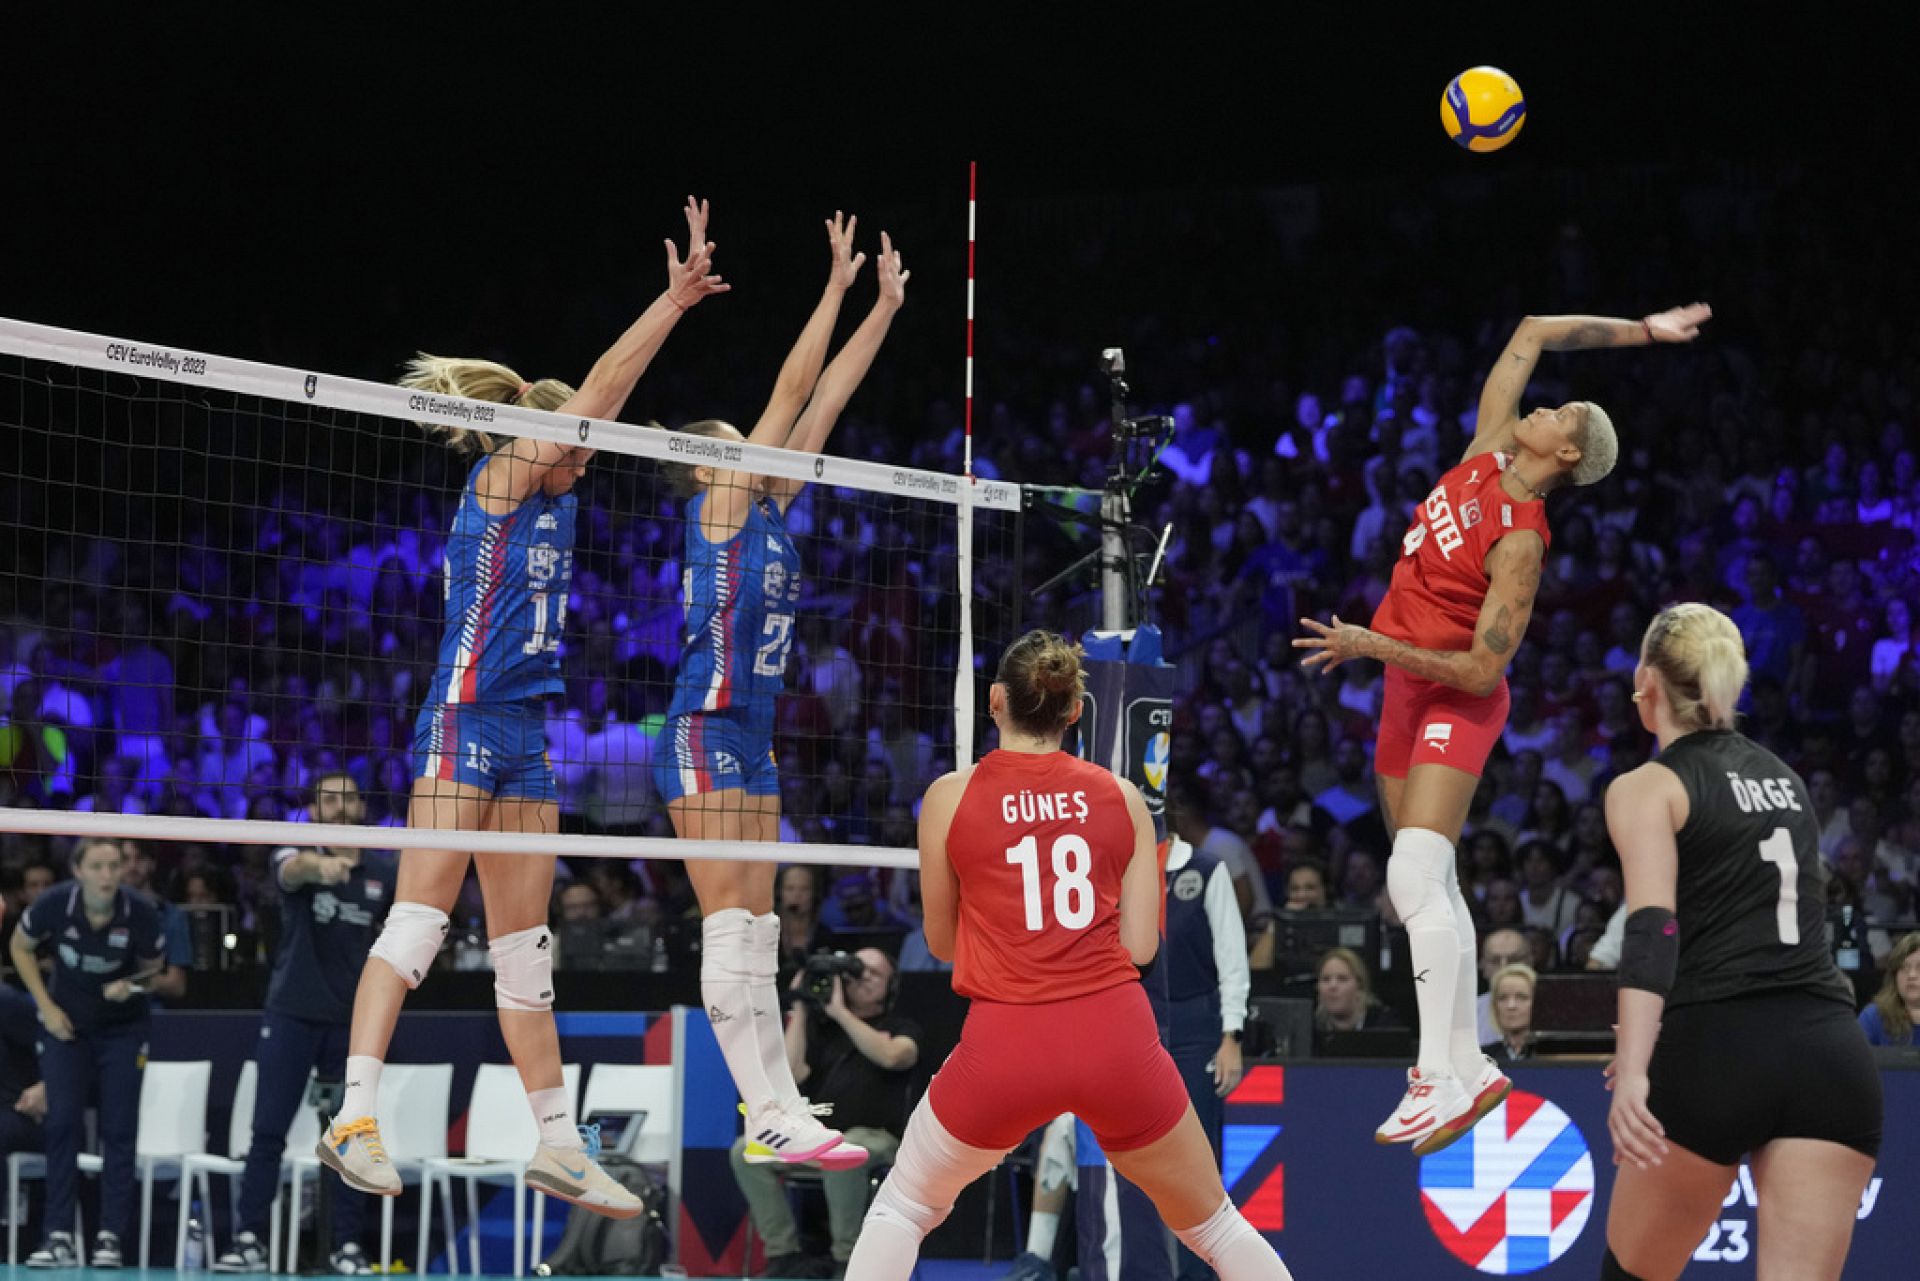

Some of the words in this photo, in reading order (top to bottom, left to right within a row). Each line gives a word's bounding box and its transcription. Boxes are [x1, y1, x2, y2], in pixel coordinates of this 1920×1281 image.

[106, 343, 130, 362] CEV
[129, 346, 181, 376] EuroVolley
[181, 356, 207, 376] 2023
[409, 395, 429, 412] CEV
[1002, 789, 1089, 824] GÜNEŞ
[1725, 770, 1803, 813] ÖRGE
[1006, 833, 1096, 931] 18
[1758, 826, 1800, 945] 1
